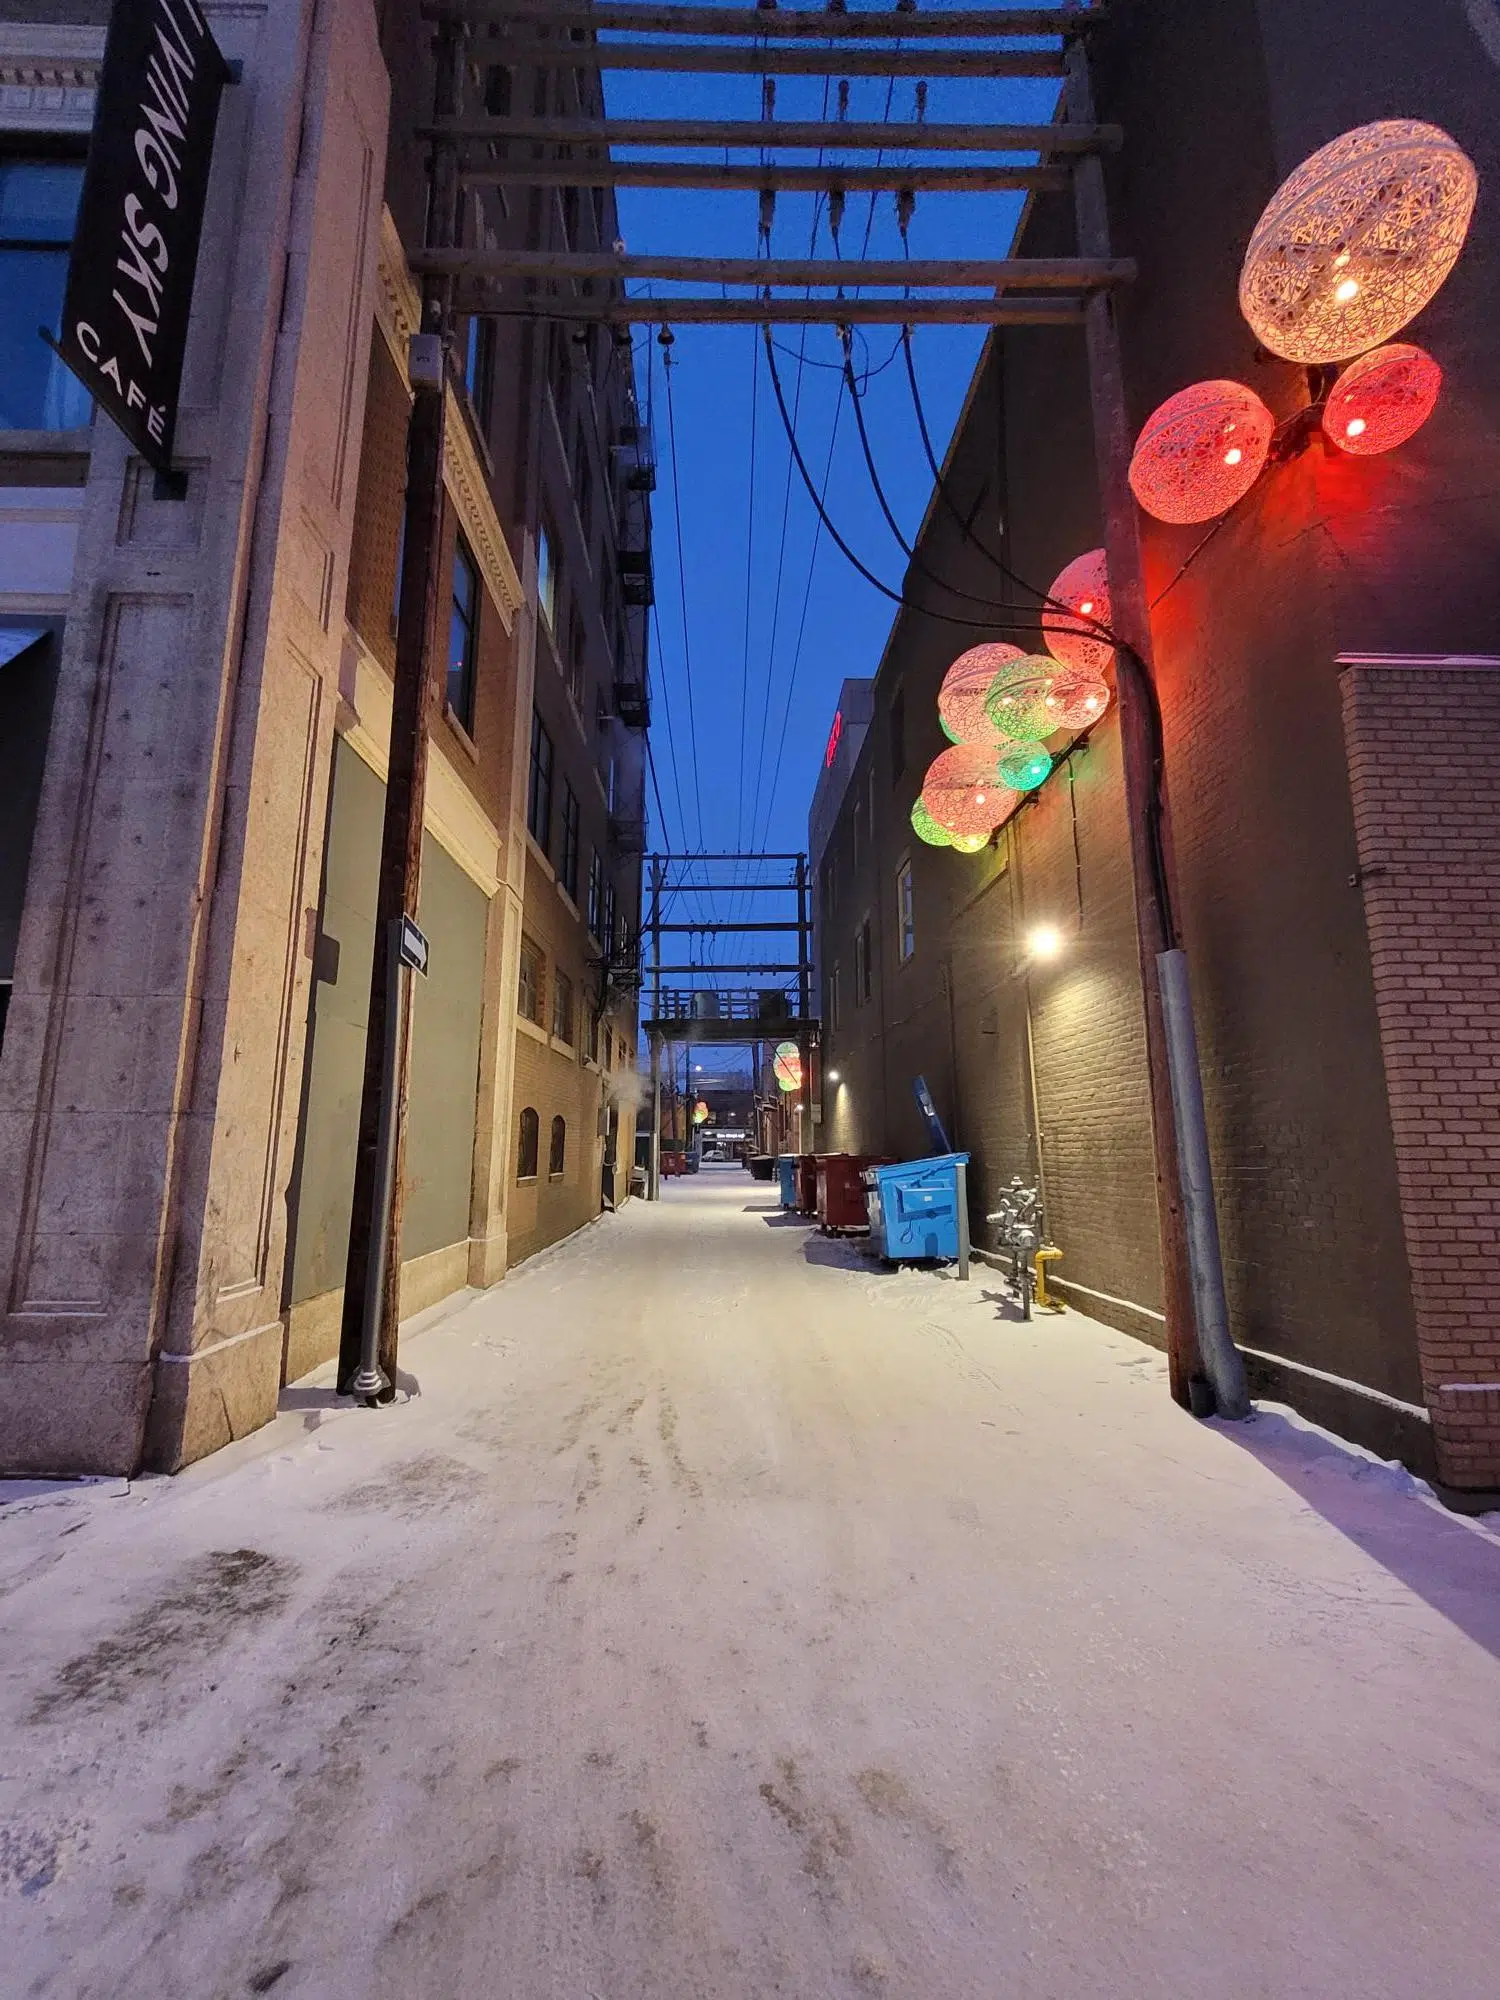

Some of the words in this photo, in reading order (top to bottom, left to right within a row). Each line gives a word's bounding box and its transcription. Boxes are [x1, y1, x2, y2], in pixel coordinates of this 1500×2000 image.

[134, 0, 204, 209] IVING
[112, 192, 169, 368] SKY
[76, 321, 166, 446] CAFÉ
